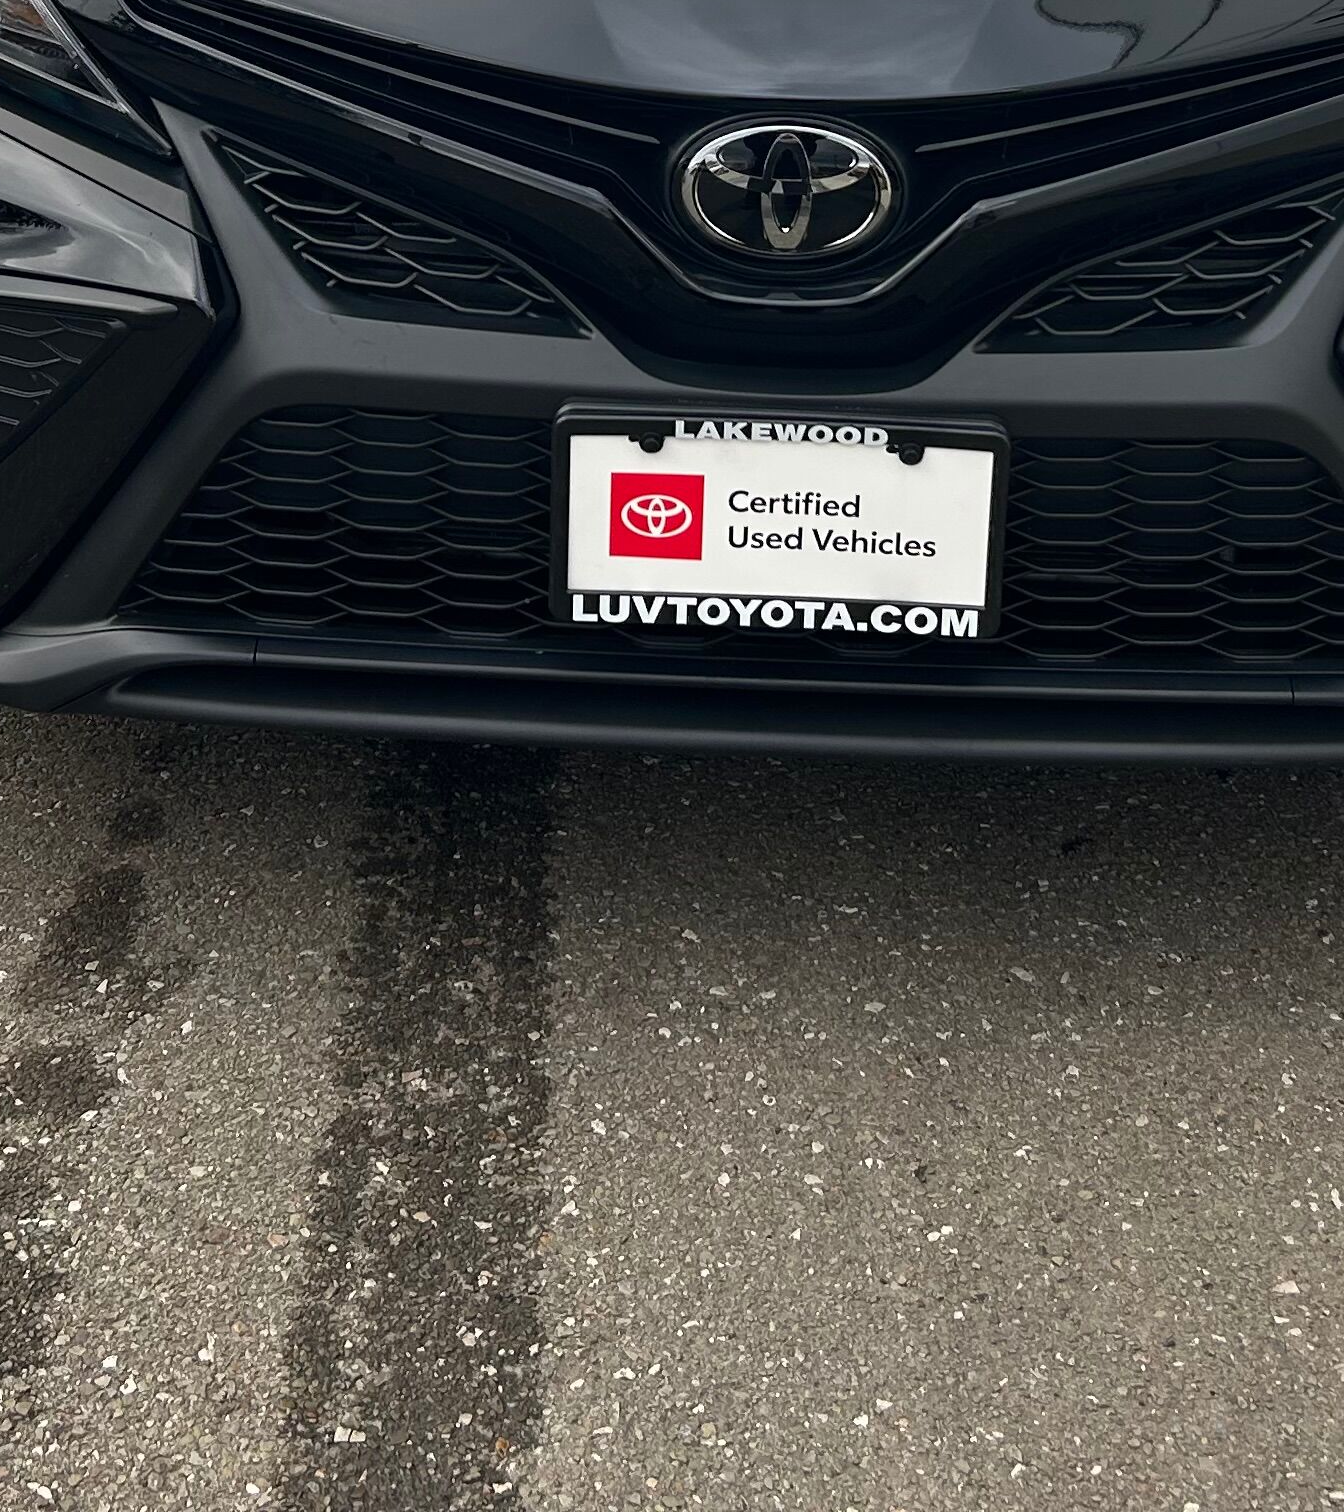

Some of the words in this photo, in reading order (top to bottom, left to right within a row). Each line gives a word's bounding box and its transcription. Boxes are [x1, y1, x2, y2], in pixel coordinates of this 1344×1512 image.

[675, 419, 890, 447] LAKEWOOD
[728, 490, 861, 519] Certified
[728, 526, 804, 551] Used
[812, 528, 937, 558] Vehicles
[571, 594, 979, 638] LUVTOYOTA.COM
